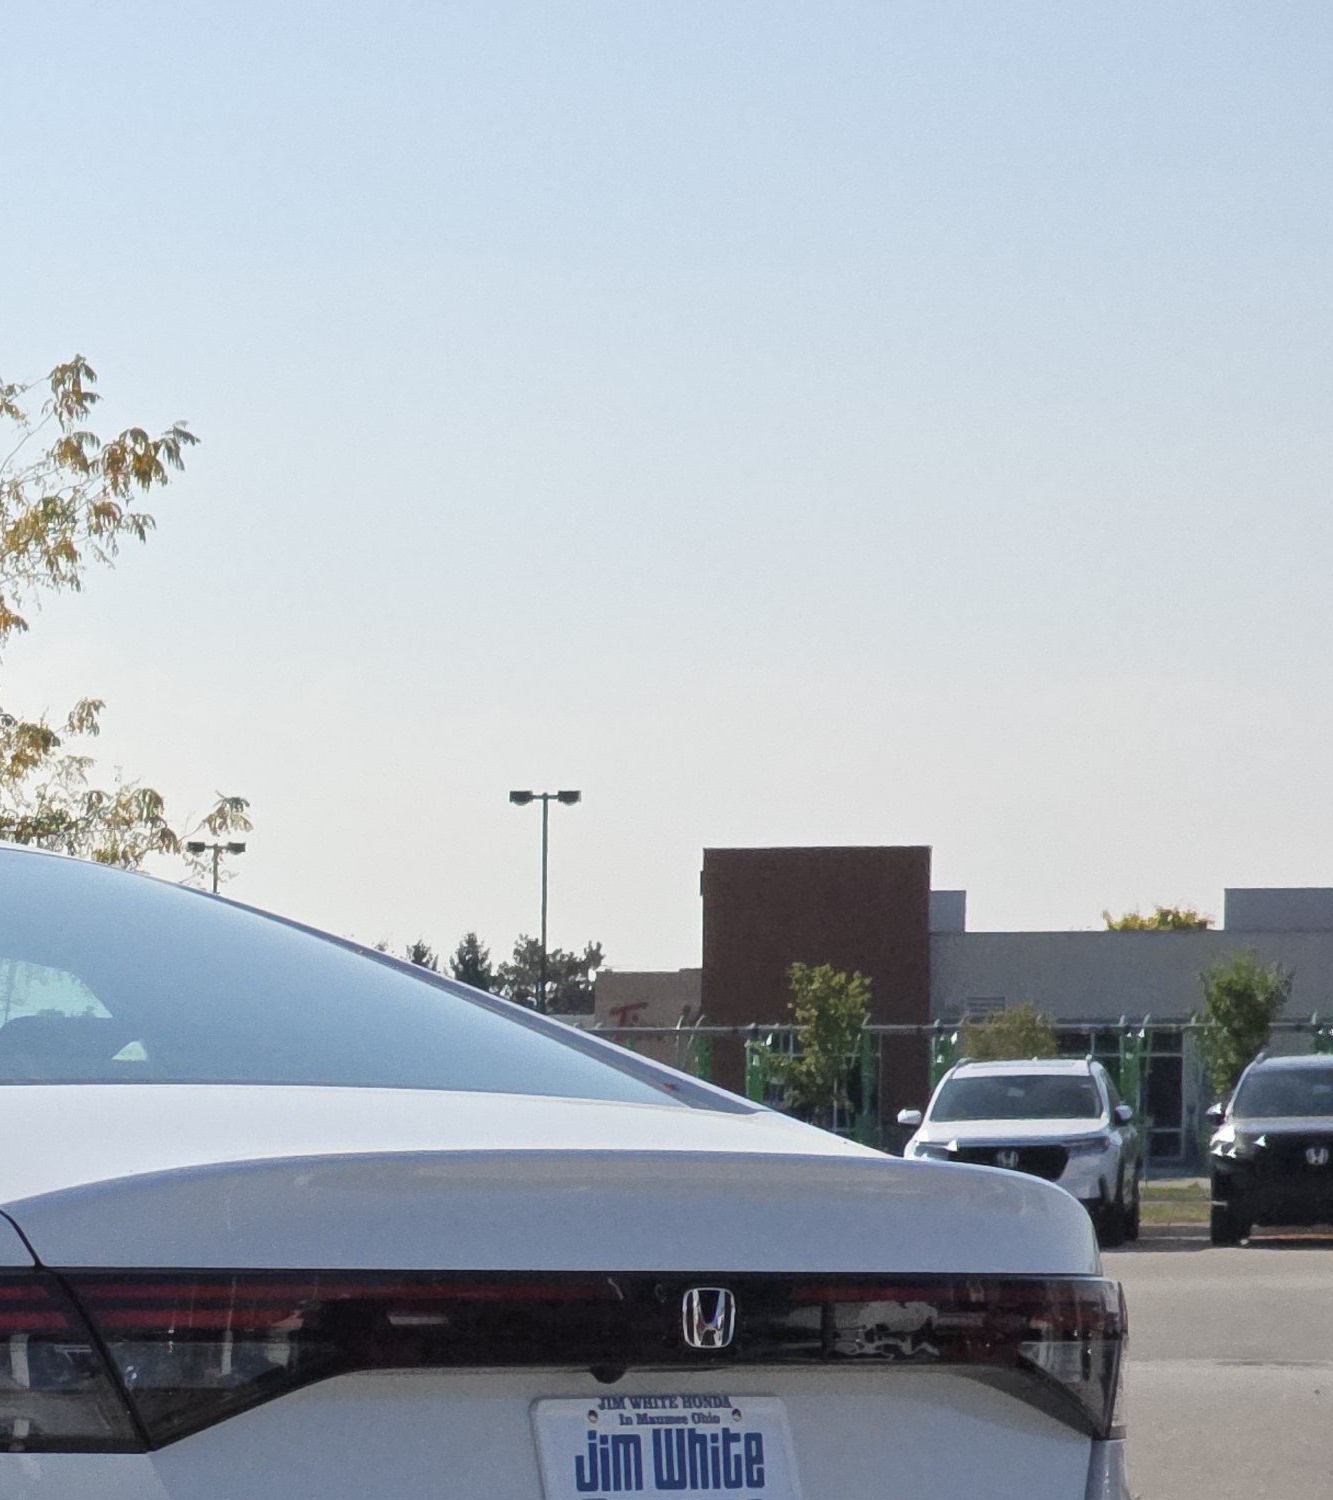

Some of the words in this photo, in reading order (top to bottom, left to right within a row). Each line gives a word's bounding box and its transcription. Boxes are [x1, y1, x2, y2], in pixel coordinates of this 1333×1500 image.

[597, 1396, 626, 1410] JIM
[628, 1395, 679, 1409] WHITE
[680, 1395, 733, 1409] HONDA
[652, 1427, 765, 1490] White
